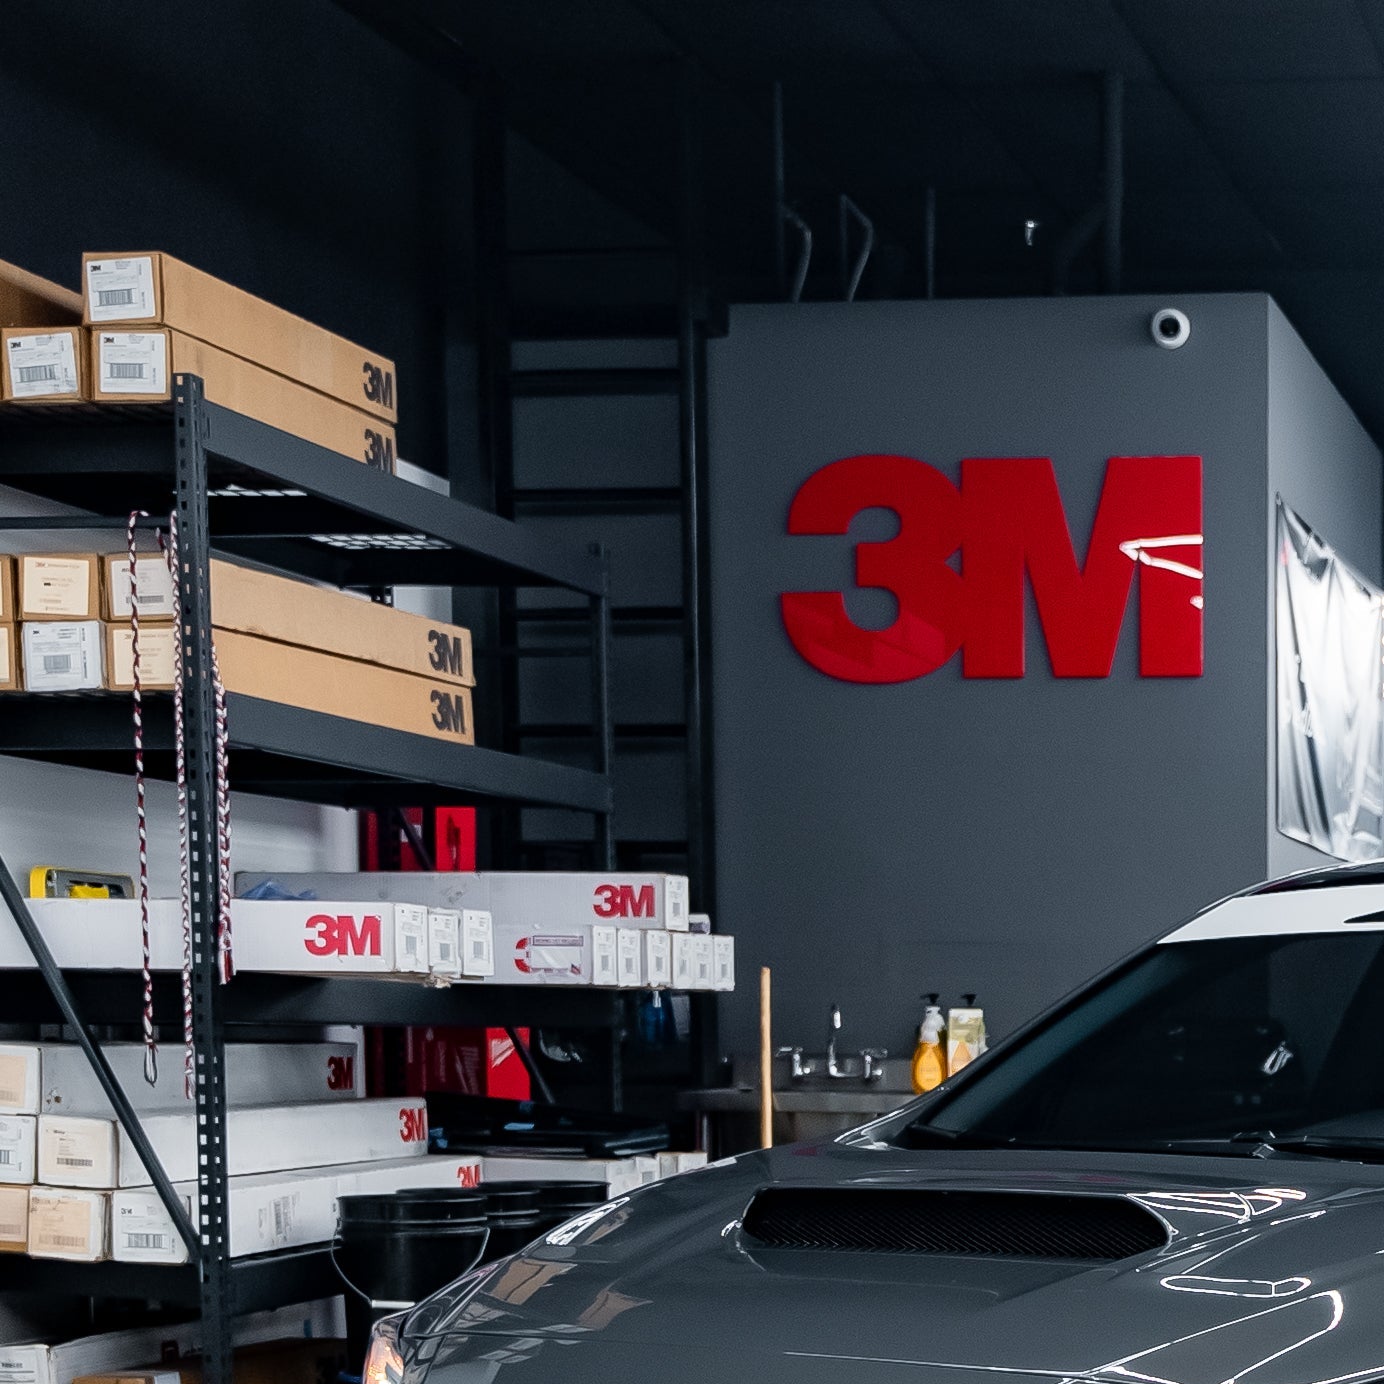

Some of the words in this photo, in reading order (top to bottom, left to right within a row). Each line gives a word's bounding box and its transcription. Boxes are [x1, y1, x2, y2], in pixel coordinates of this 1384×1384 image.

[362, 361, 393, 409] 3M
[364, 428, 393, 475] 3M
[780, 454, 1203, 684] 3M
[428, 629, 463, 677] 3M
[430, 689, 466, 734] 3M
[592, 884, 656, 918] 3M
[304, 914, 383, 957] 3M
[326, 1055, 354, 1091] 3M
[399, 1107, 425, 1143] 3M
[456, 1164, 480, 1188] 3M
